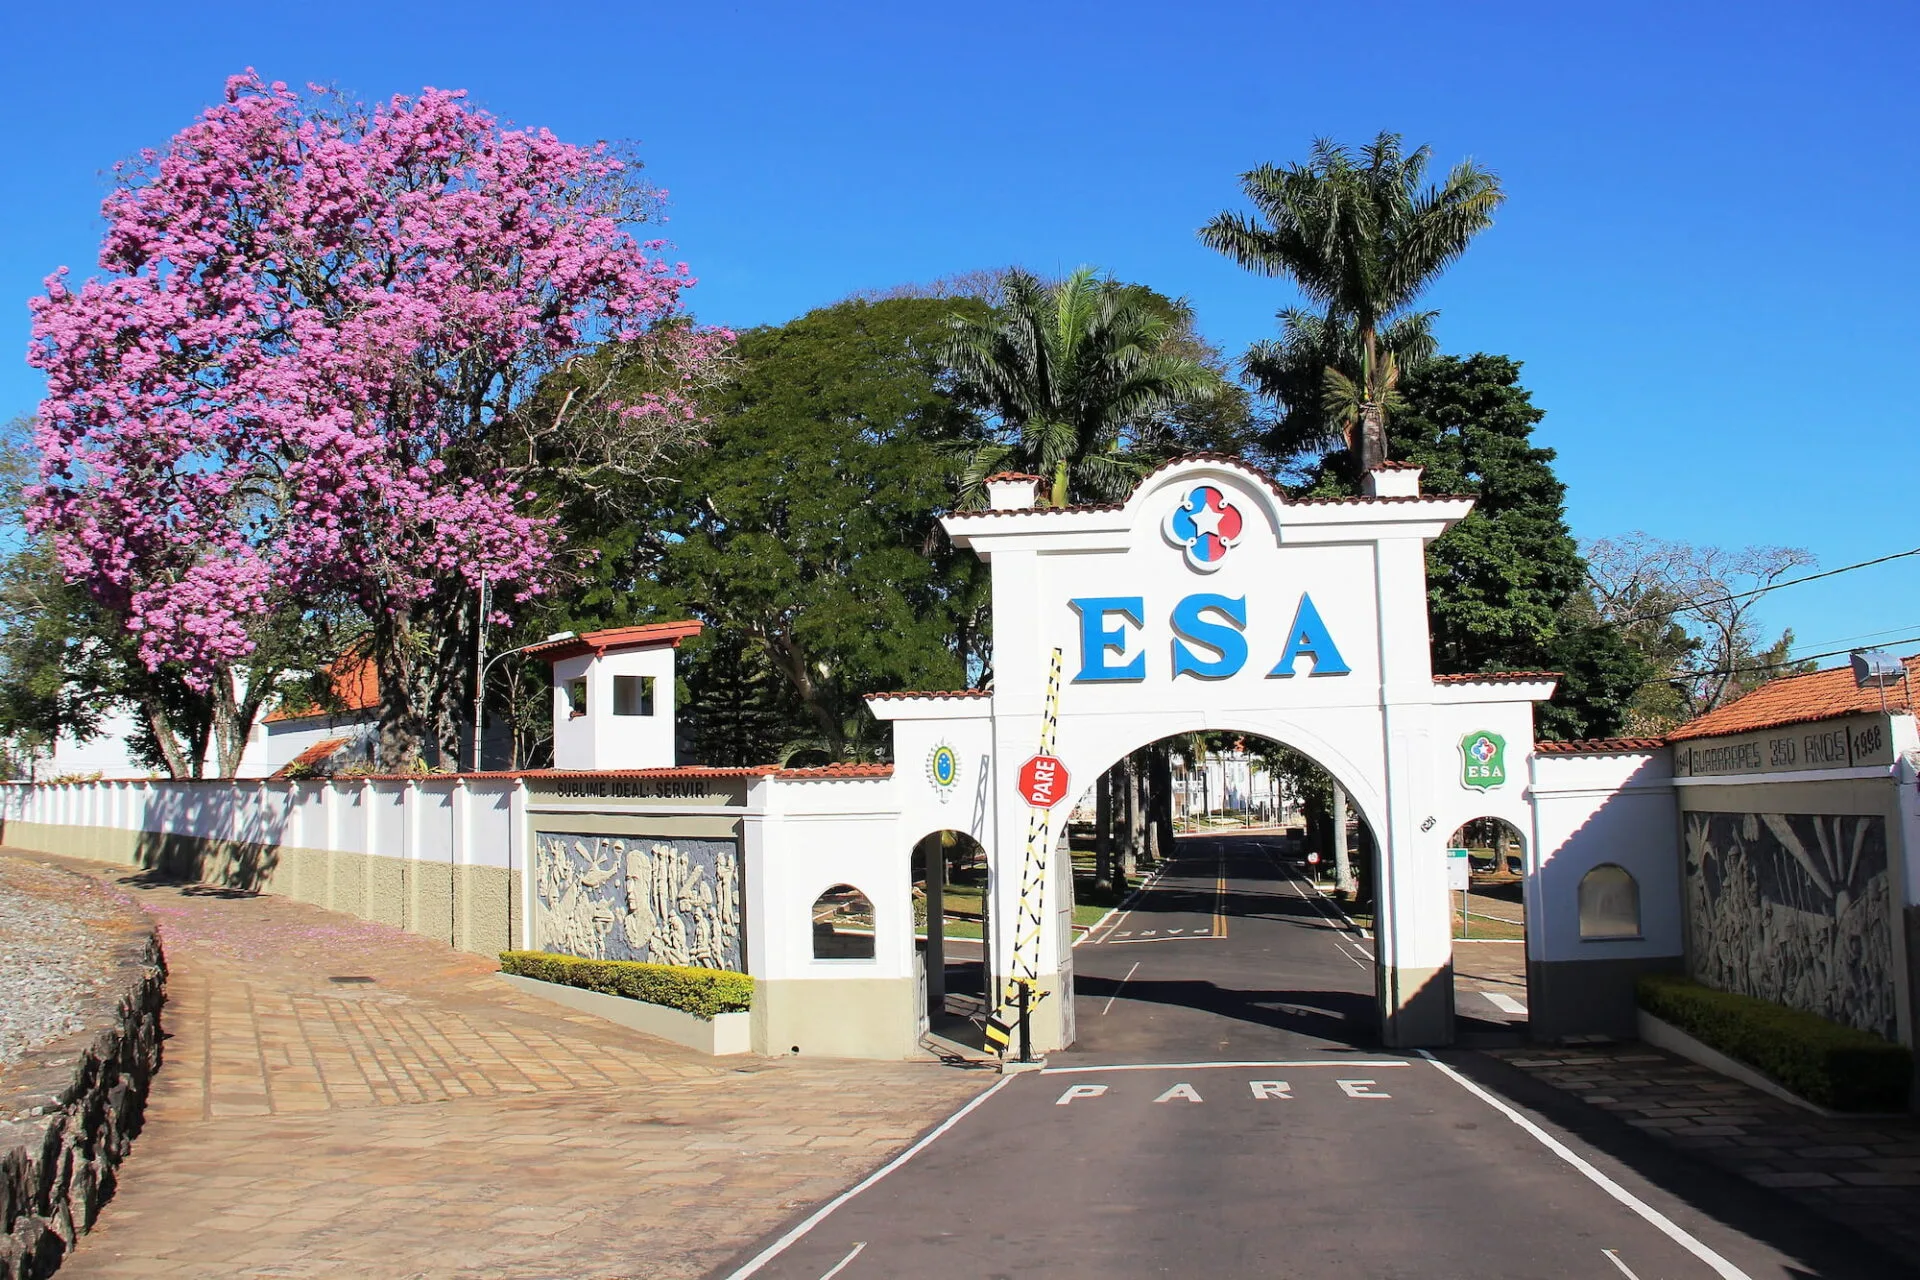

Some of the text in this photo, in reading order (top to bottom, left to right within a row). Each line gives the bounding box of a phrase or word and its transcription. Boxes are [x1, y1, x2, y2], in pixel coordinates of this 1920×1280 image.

[1067, 591, 1352, 684] ESA
[1693, 742, 1761, 773] GUARARAPES
[1769, 737, 1796, 766] 350
[1804, 731, 1845, 764] ANOS
[1854, 725, 1882, 760] 1998
[1032, 760, 1056, 803] PARE
[1468, 765, 1502, 778] ESA
[557, 781, 710, 798] SUBLIME IDEAL: SERVIR!
[1056, 1079, 1392, 1105] PARE
